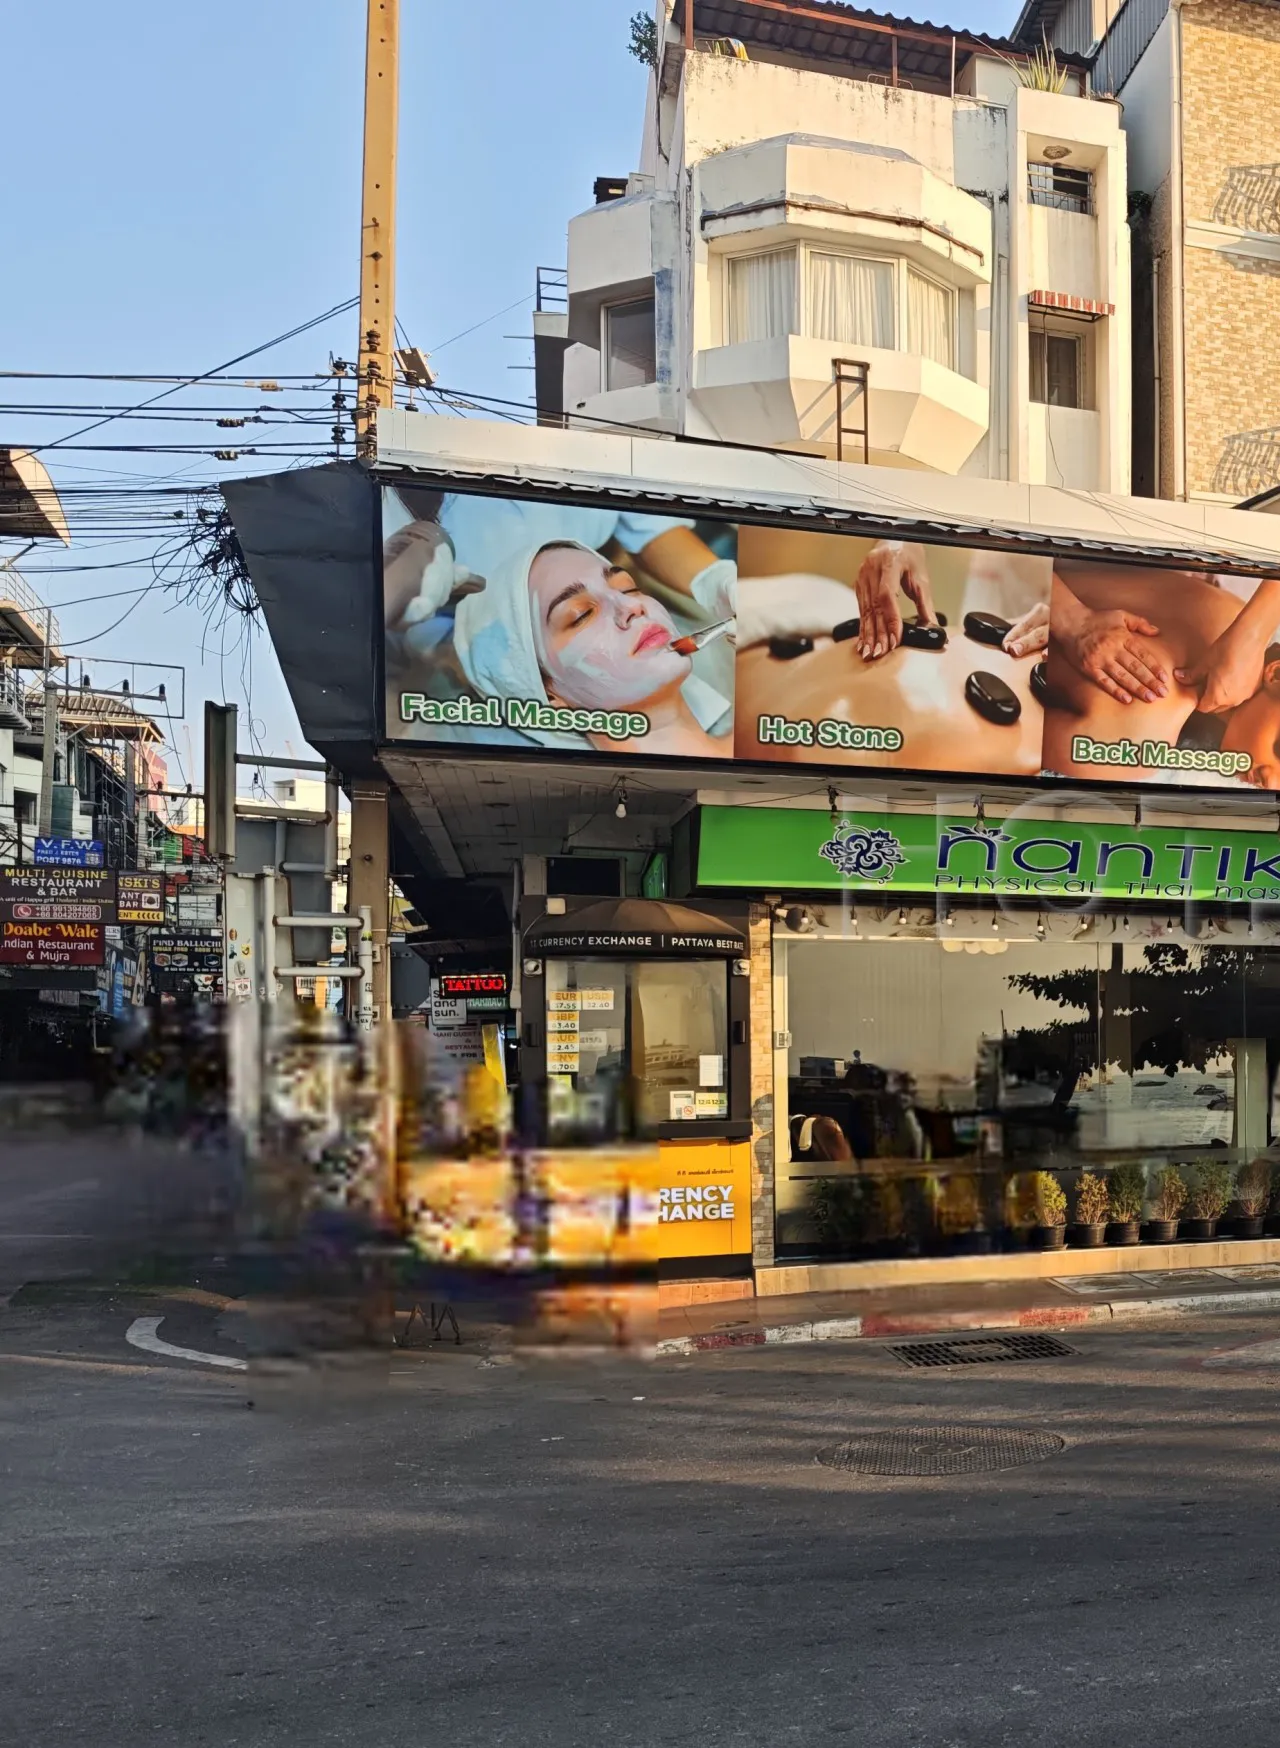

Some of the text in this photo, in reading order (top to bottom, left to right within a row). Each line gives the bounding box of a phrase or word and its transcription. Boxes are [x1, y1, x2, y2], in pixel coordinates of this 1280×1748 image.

[401, 693, 648, 738] Facial Massage
[758, 716, 901, 750] Hot Stone
[1073, 736, 1251, 775] Back Massage
[36, 856, 61, 864] POST
[5, 869, 108, 879] MULTI CUISINE
[11, 878, 102, 888] RESTAURANT
[36, 887, 77, 897] & BAR
[1, 940, 95, 950] ndian Restaurant
[539, 936, 585, 948] CURRENCY
[588, 936, 652, 946] EXCHANGE
[672, 937, 714, 948] PATTAYA
[716, 939, 732, 949] BEST
[26, 951, 70, 962] & Mujra
[445, 978, 504, 991] TATTOO
[555, 992, 577, 1000] EUR
[433, 998, 457, 1007] and
[434, 1009, 460, 1017] sun.
[659, 1185, 733, 1204] RENCY
